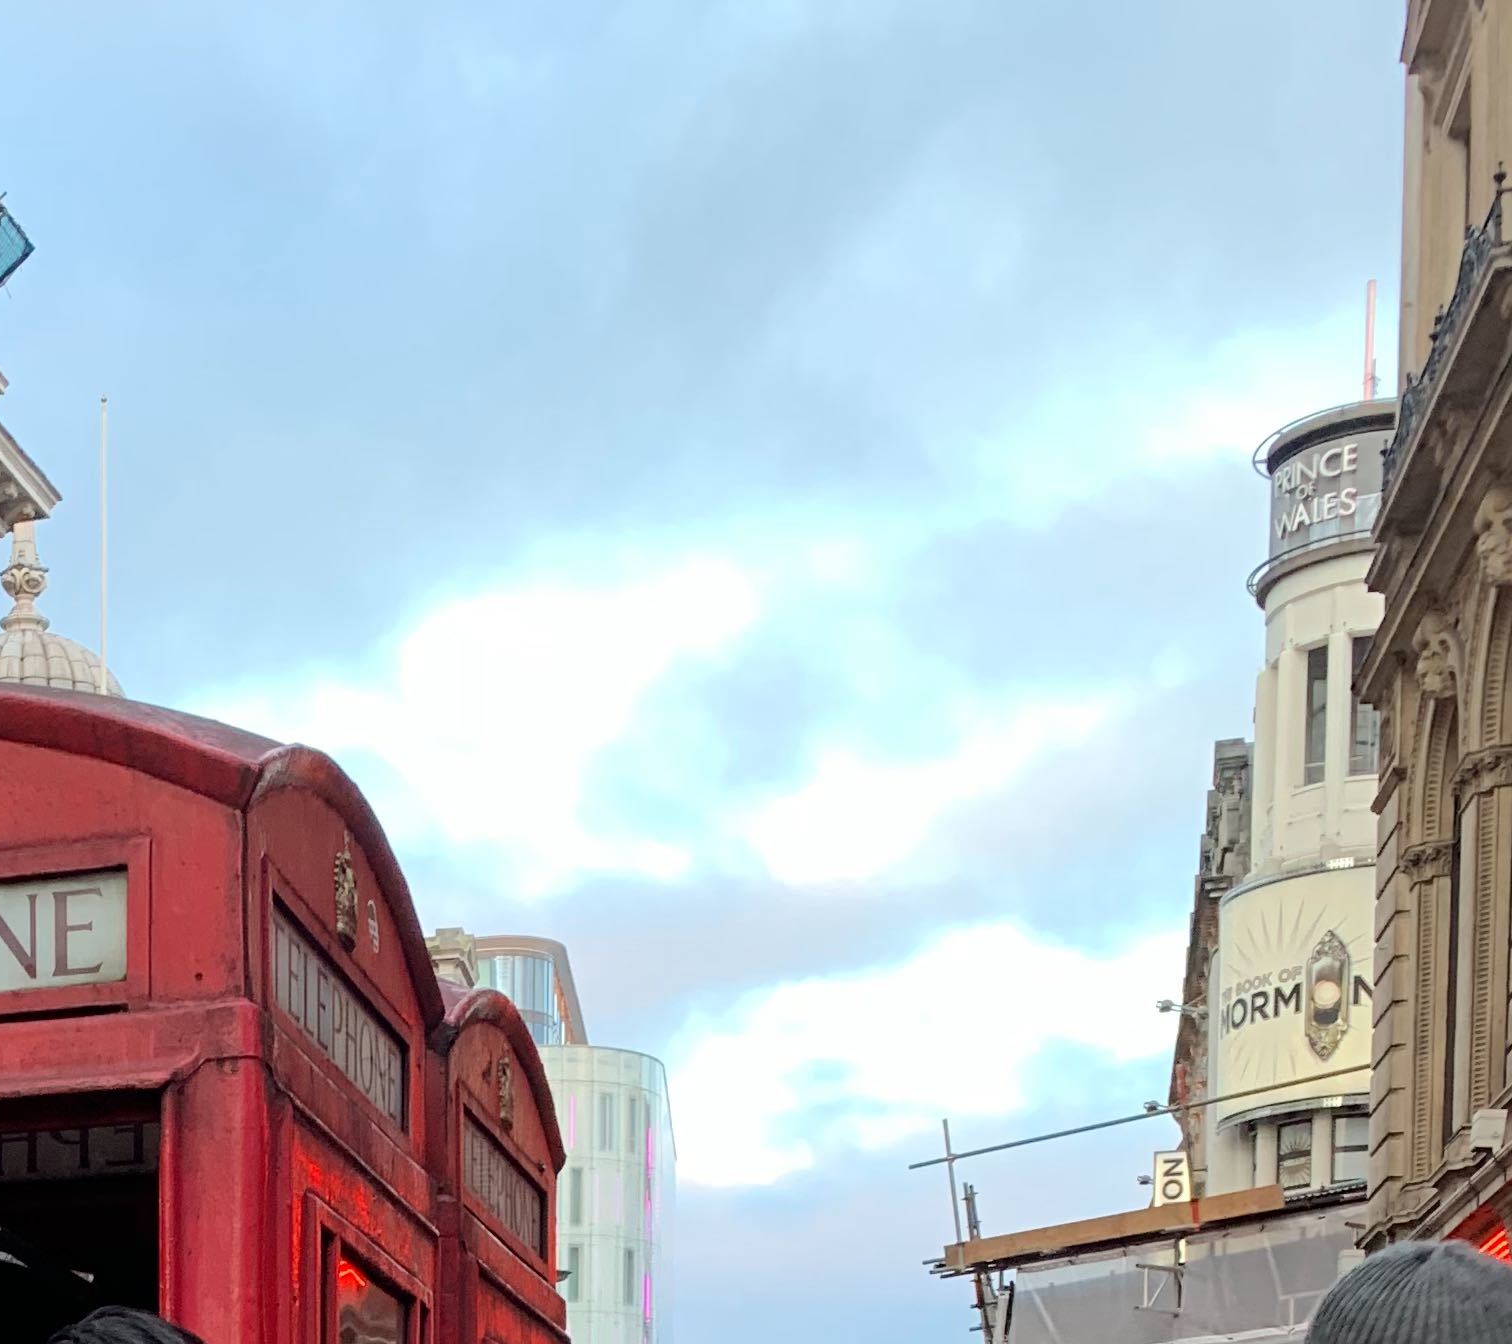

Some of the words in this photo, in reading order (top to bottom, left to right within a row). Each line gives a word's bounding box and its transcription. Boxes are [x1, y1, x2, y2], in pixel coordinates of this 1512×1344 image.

[1274, 443, 1359, 498] PRINCE
[1295, 481, 1316, 501] OF
[1274, 487, 1358, 540] WALES
[274, 916, 398, 1122] TELEPHONE
